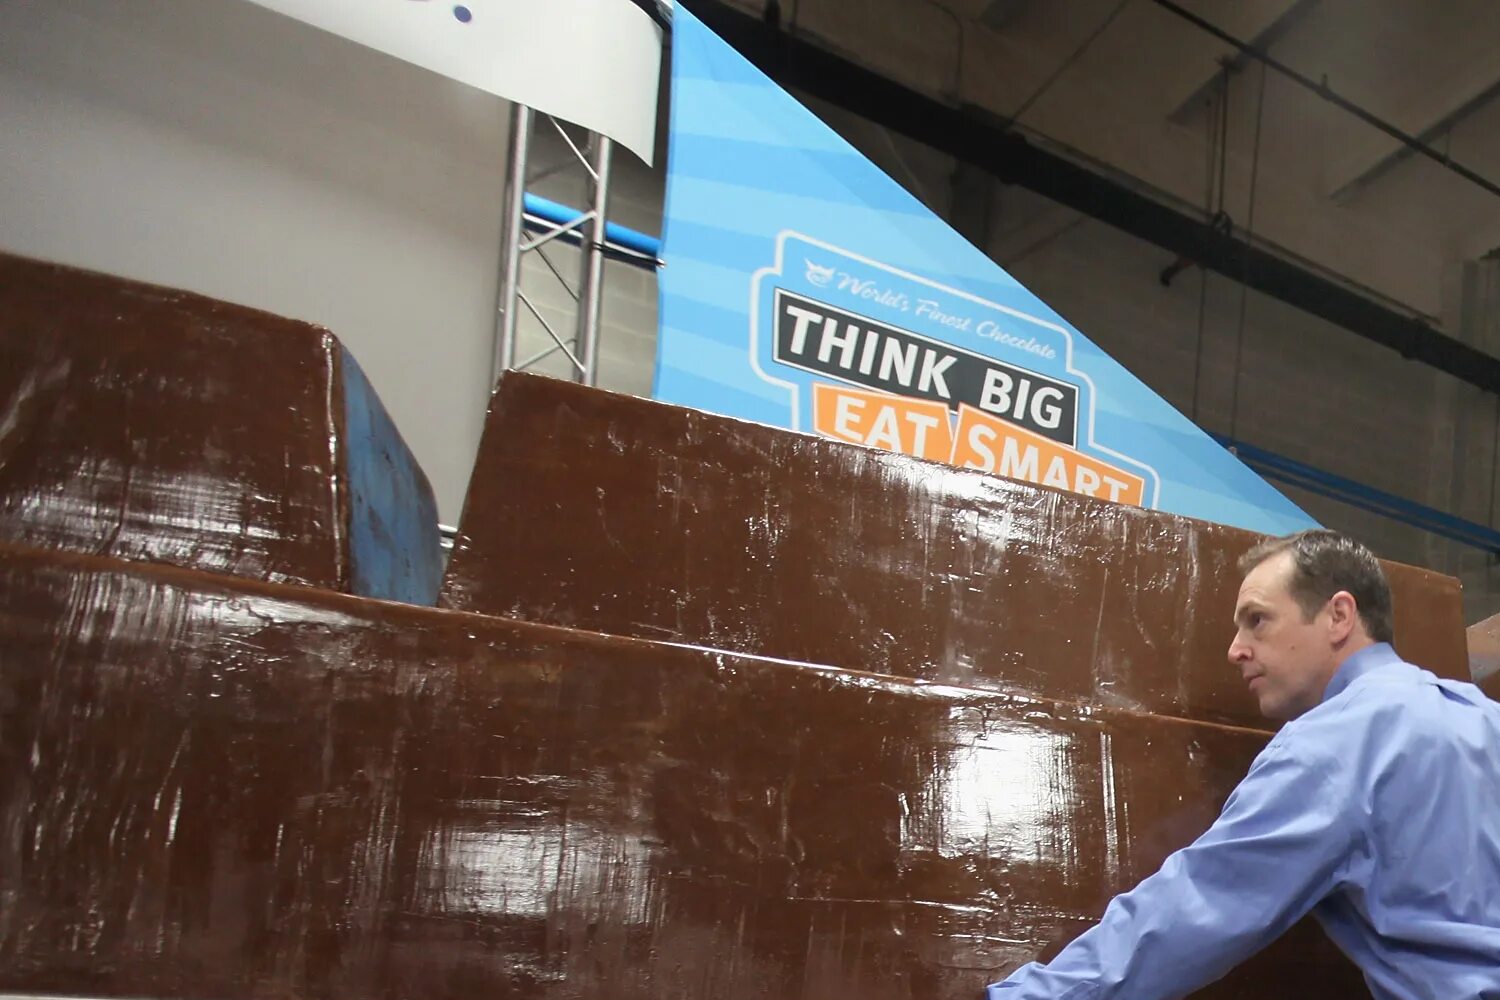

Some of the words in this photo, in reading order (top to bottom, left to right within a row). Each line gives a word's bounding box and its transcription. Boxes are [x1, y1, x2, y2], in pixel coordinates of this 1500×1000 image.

[786, 305, 957, 399] THINK
[979, 368, 1064, 429] BIG
[836, 271, 909, 312] World's
[914, 298, 972, 333] Finest
[976, 320, 1056, 360] Chocolate
[834, 395, 939, 458] EAT
[964, 424, 1129, 501] SMART
